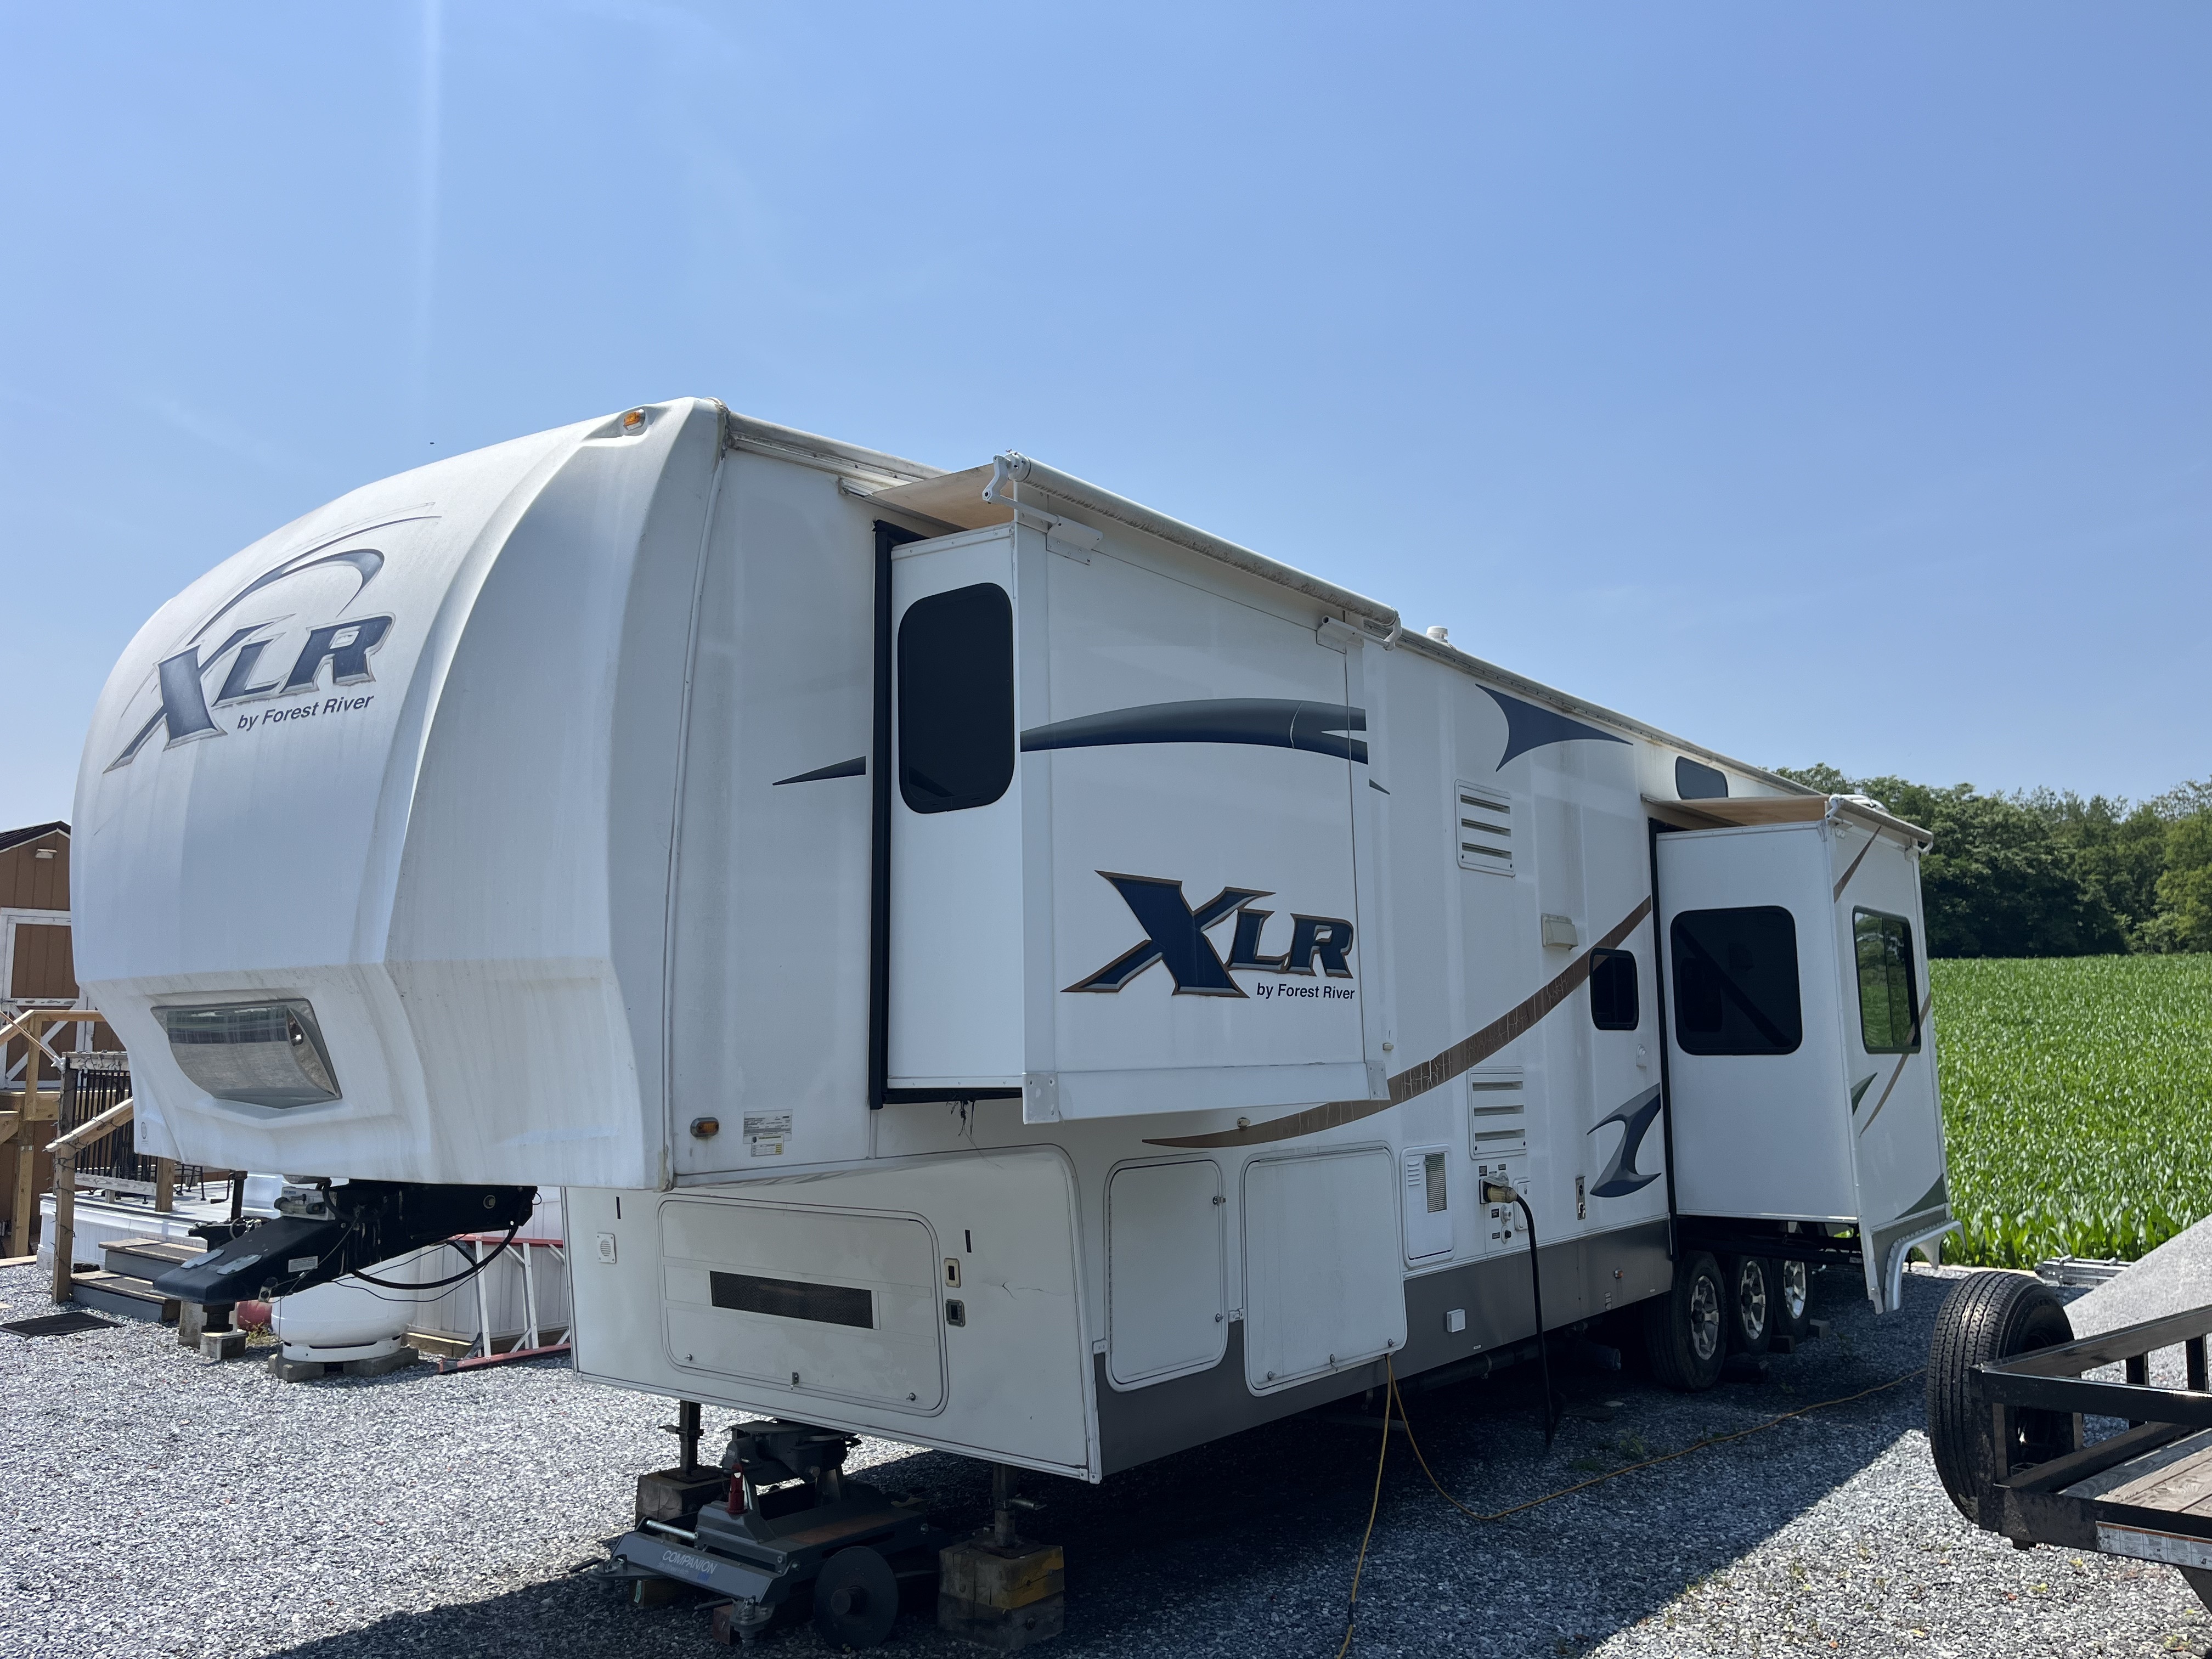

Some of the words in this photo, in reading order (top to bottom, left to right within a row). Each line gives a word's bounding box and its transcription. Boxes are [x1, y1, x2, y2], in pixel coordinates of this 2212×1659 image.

[103, 612, 396, 774] XLR
[237, 714, 259, 731] by
[262, 702, 319, 725] Forest
[323, 696, 374, 714] River
[1060, 870, 1353, 998] XLR
[1257, 983, 1273, 999] by
[1278, 984, 1319, 997] Forest
[1323, 986, 1355, 999] River
[662, 1550, 718, 1574] COMPANION
